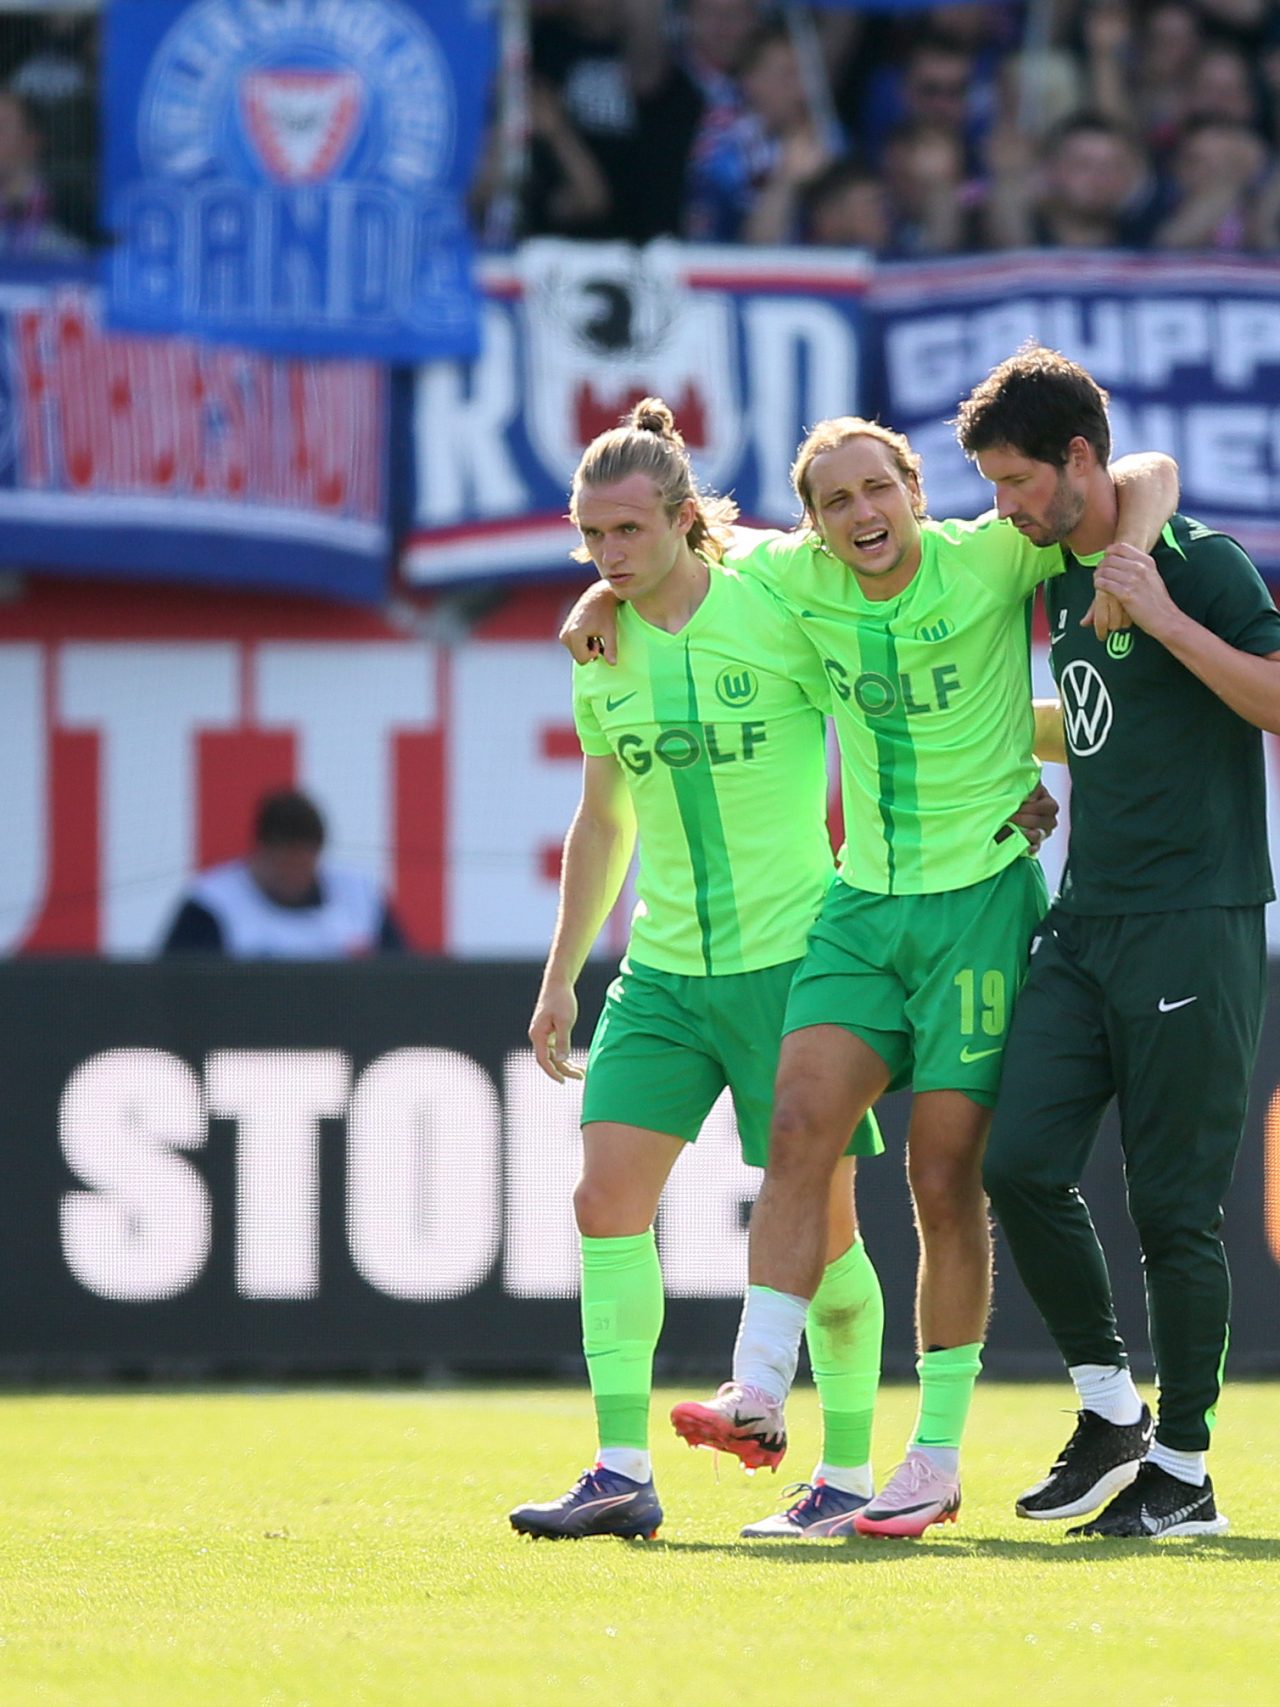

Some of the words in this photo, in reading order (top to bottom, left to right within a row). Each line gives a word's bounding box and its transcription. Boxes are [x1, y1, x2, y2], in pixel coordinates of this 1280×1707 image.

[825, 659, 961, 717] GOLF
[617, 721, 767, 776] GOLF
[954, 969, 1005, 1037] 19
